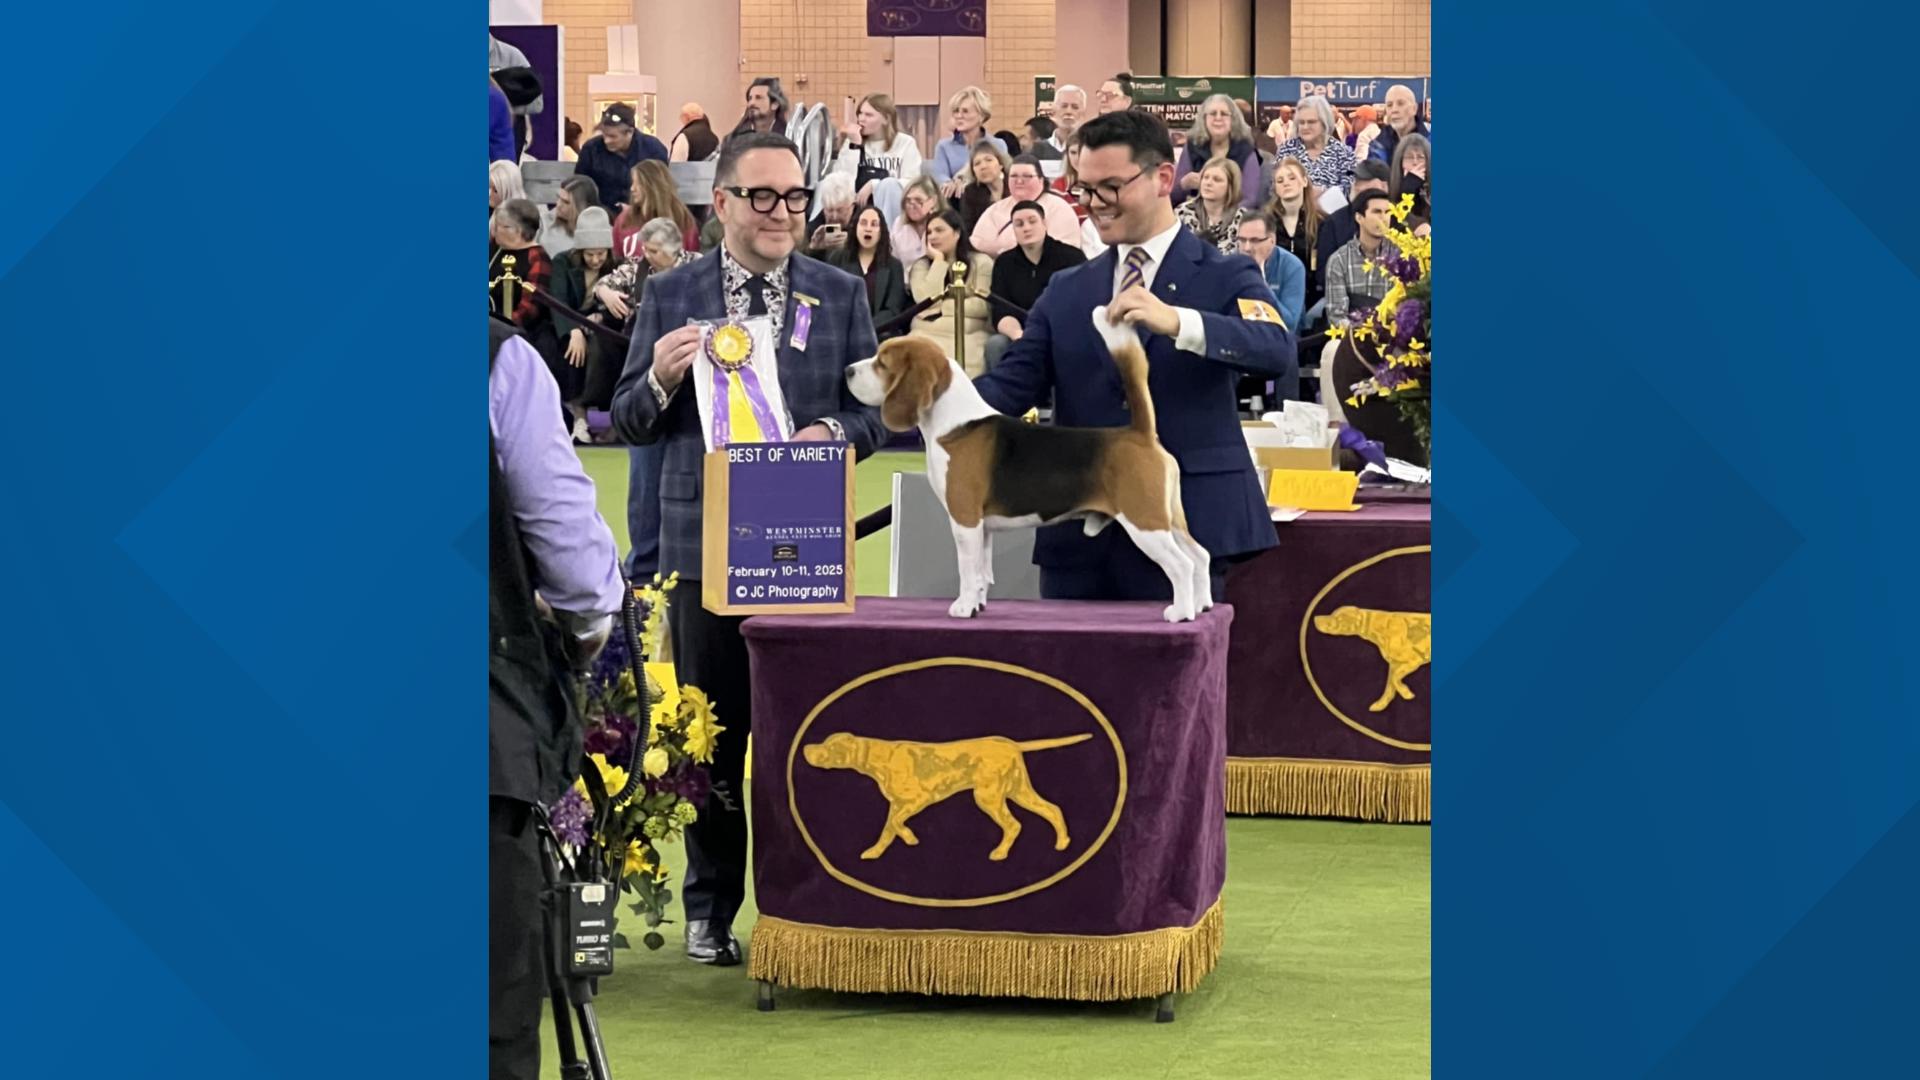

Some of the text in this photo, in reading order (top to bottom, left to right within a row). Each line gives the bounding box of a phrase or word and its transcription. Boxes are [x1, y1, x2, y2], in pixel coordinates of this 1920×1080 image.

[1301, 81, 1377, 99] PetTurf
[728, 446, 845, 463] BEST OF VARIETY
[766, 526, 842, 535] WESTMINSTER
[728, 566, 777, 579] February
[814, 564, 844, 577] 2025
[750, 585, 764, 599] JC
[768, 584, 839, 600] Photography
